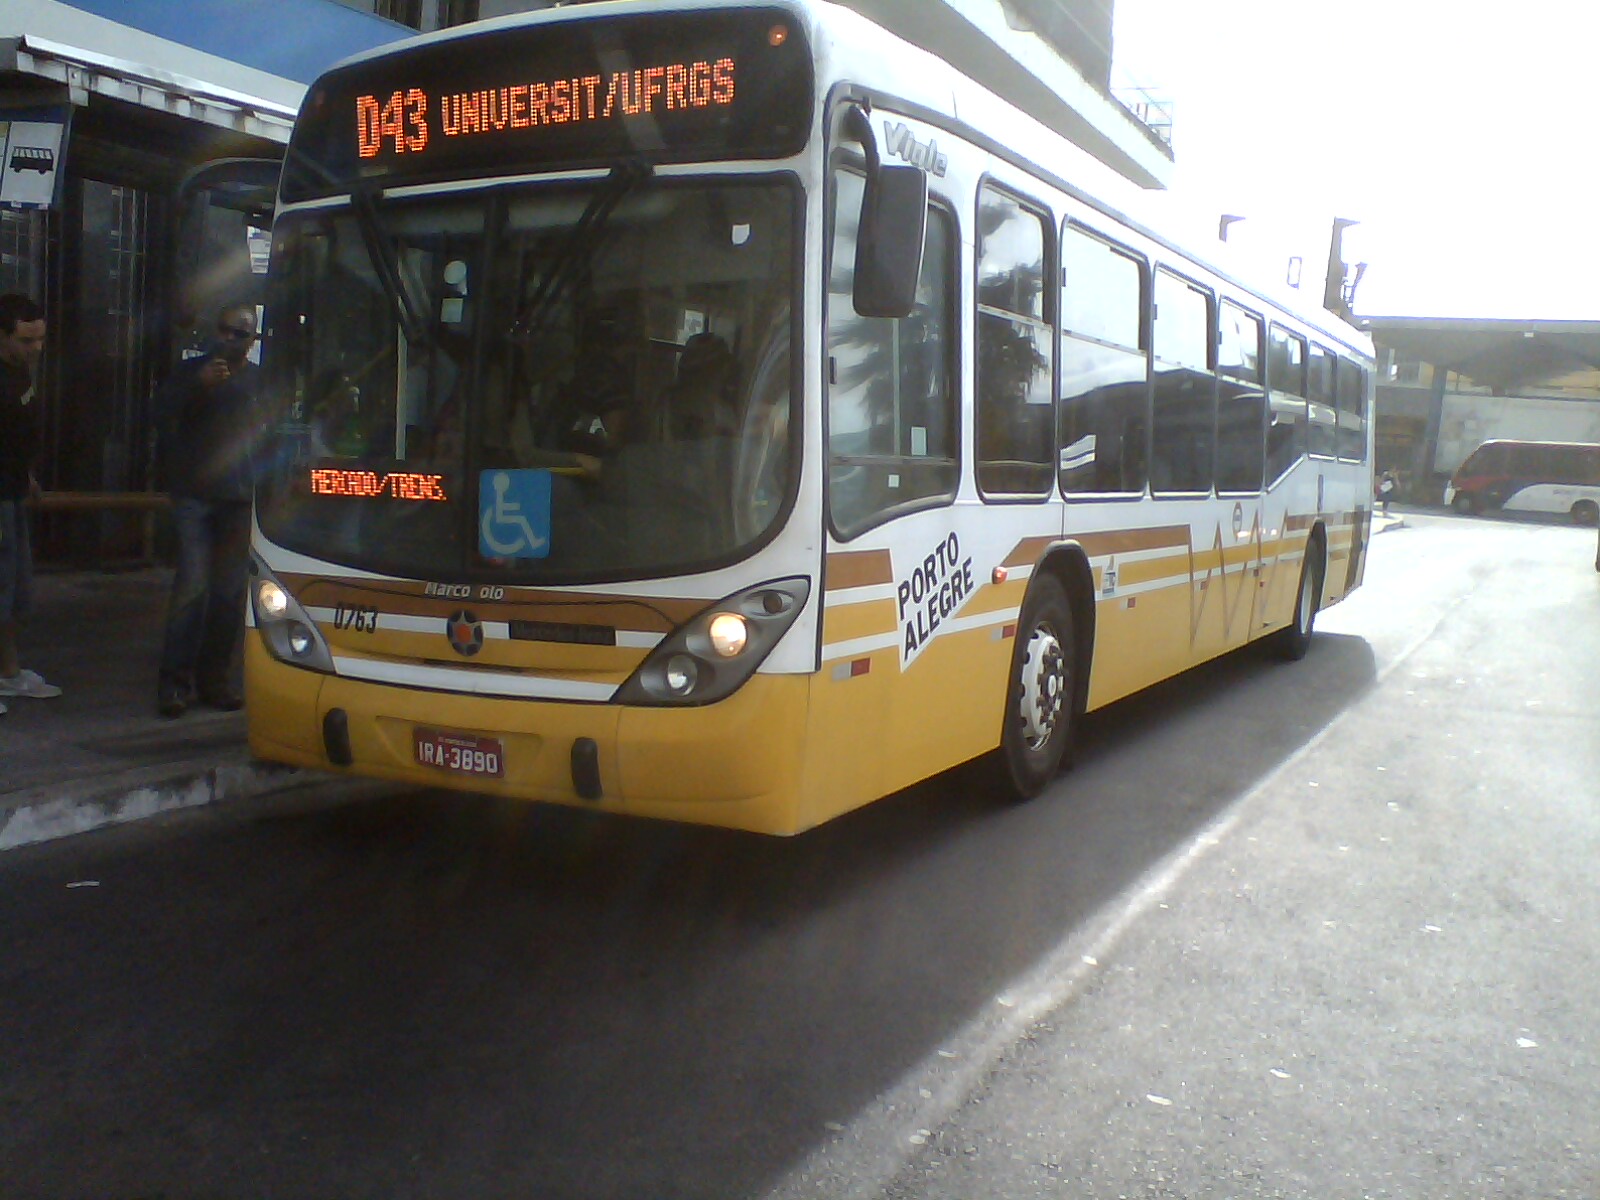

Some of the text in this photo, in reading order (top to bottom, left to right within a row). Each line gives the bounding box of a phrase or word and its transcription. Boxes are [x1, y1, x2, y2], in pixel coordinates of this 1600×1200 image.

[356, 57, 735, 158] D43 UNIVERSIT/UFRGS
[334, 602, 379, 634] 0763
[897, 531, 959, 621] PORTO
[904, 556, 974, 661] ALEGRE
